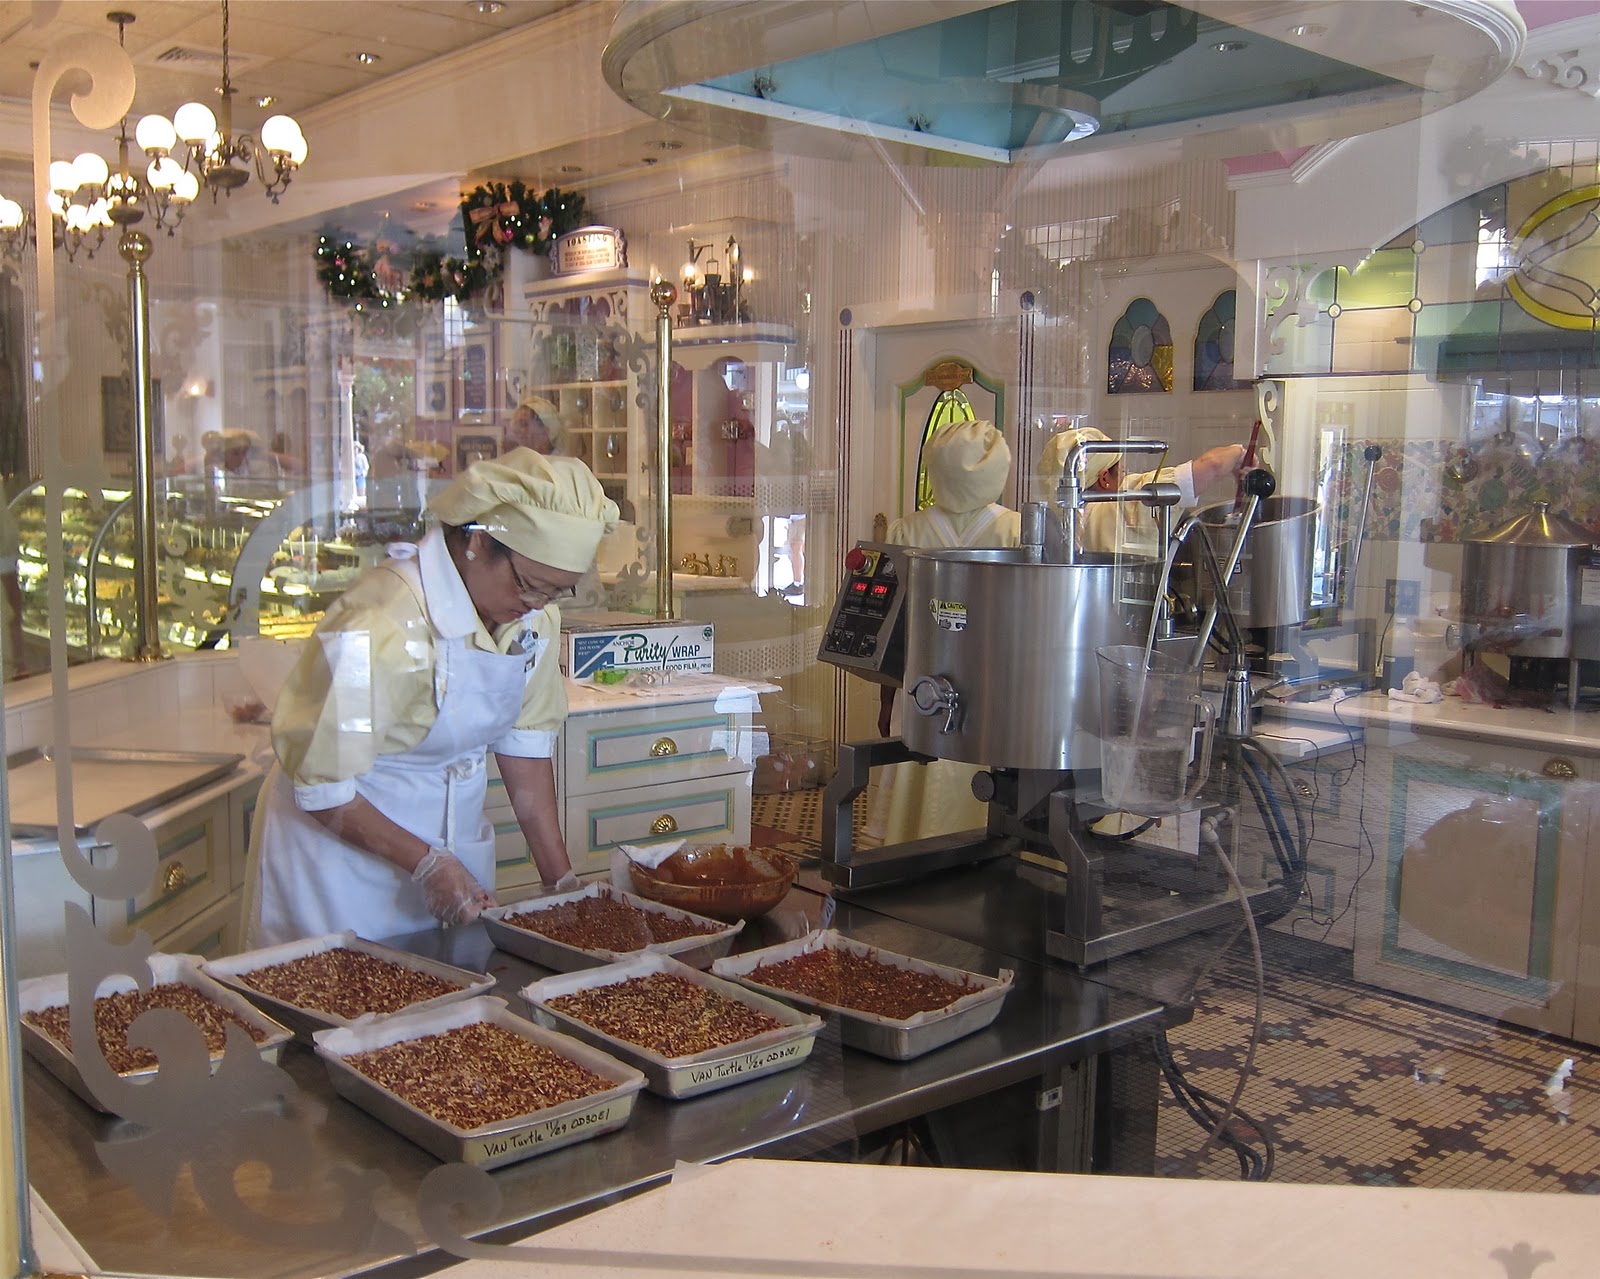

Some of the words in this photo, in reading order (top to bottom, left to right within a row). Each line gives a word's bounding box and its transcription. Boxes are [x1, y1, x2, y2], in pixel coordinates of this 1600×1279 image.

[612, 639, 635, 647] ANCHOR
[619, 633, 679, 670] Purity
[672, 644, 701, 658] WRAP
[684, 662, 697, 670] FILM
[691, 1069, 713, 1083] VAN
[715, 1061, 743, 1077] Turtle
[484, 1142, 508, 1157] VAN
[510, 1130, 544, 1148] Turtle
